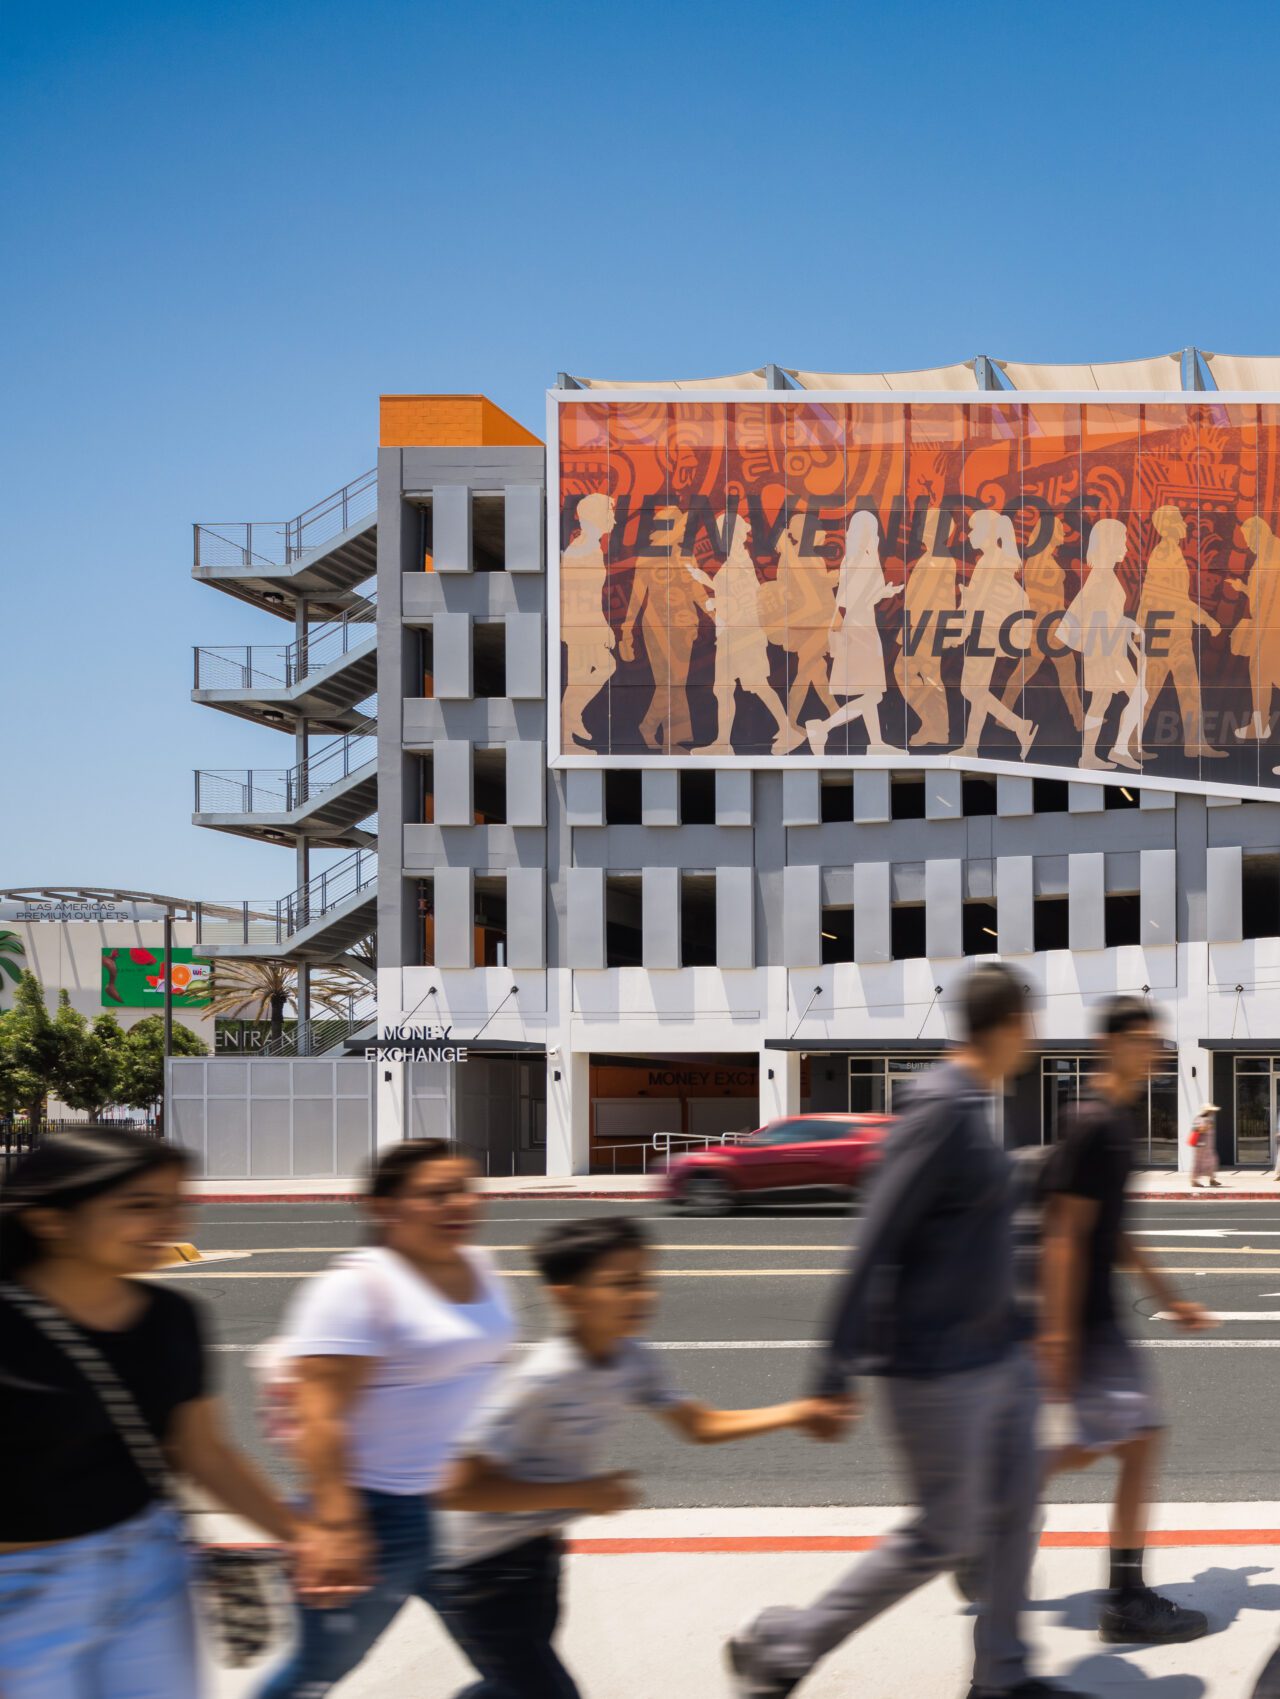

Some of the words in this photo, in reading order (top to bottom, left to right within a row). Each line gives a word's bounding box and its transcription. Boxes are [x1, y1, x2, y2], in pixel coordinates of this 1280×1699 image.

[880, 610, 1175, 658] WELCOME
[29, 903, 51, 911] LAS
[54, 903, 116, 911] AMERICAS
[16, 912, 72, 920] PREMIUM
[74, 912, 129, 920] OUTLETS
[214, 1030, 322, 1047] ENTRANE
[384, 1025, 453, 1041] MONEY
[364, 1047, 468, 1063] EXCHANGE
[906, 1062, 929, 1070] SUITE
[648, 1071, 710, 1086] MONEY
